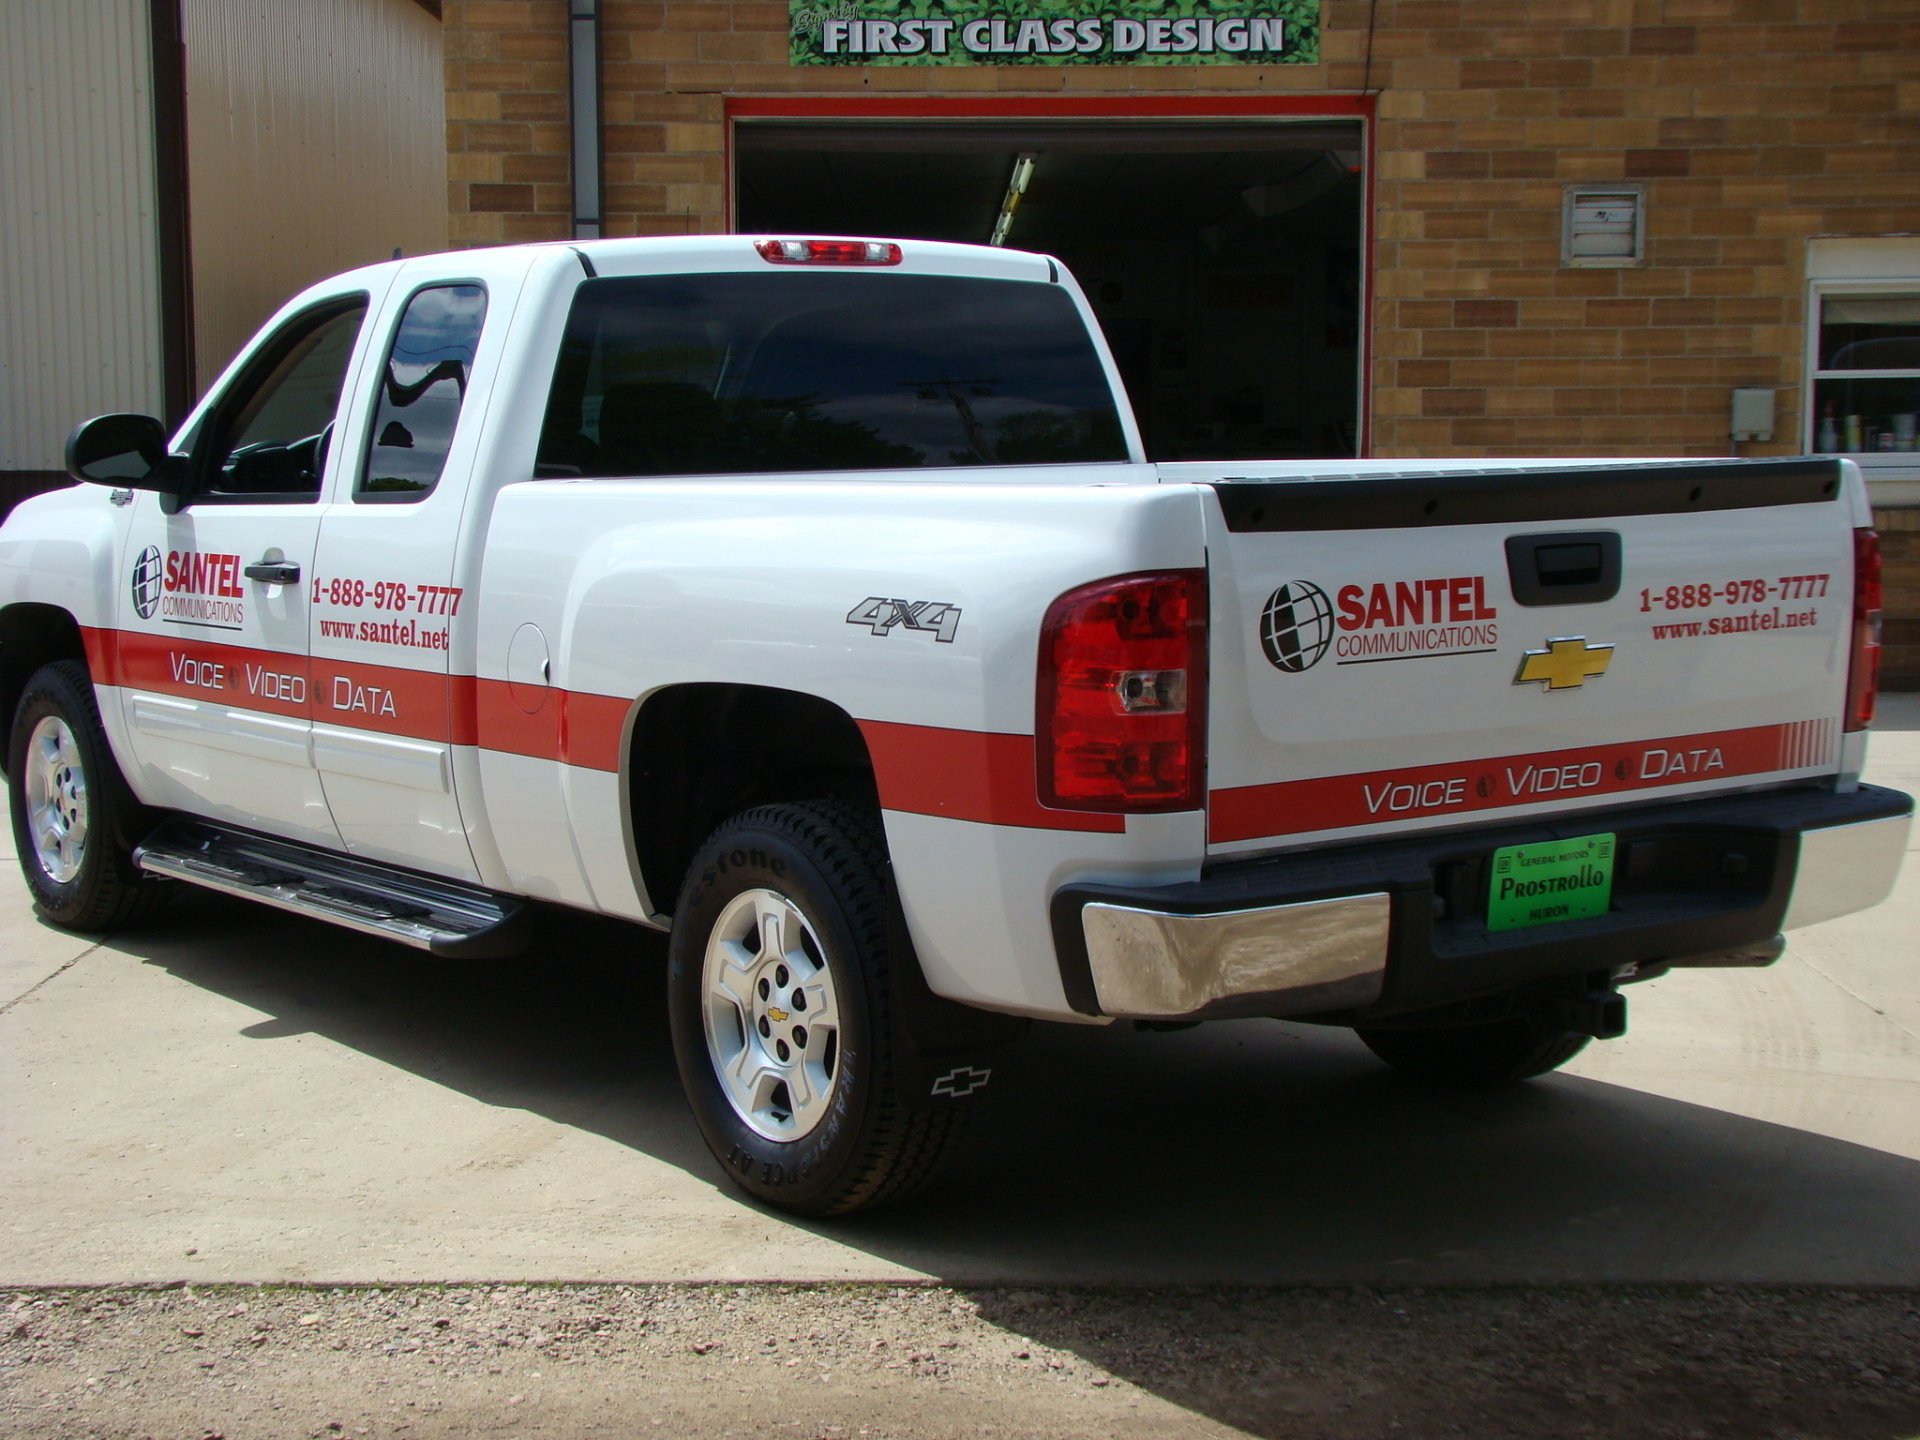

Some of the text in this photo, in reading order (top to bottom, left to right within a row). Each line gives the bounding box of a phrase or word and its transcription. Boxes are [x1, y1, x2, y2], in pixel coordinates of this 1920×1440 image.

[822, 18, 1284, 54] FIRST CLASS DESIGN
[164, 550, 244, 599] SANTEL
[162, 596, 243, 623] COMMUNICATIONS
[312, 577, 463, 616] 1-888-978-7777
[1336, 576, 1496, 631] SANTEL
[1640, 574, 1830, 613] 1-888-978-7777
[320, 619, 449, 650] www.santel.net
[846, 596, 962, 643] 4X4
[1651, 606, 1818, 641] www.santel.net
[1337, 624, 1497, 658] COMMUNICATIONS
[170, 651, 396, 718] VOICE VIDEO DATA
[1364, 747, 1724, 814] VOICE VIDEO DATA
[1520, 855, 1555, 867] GENERAL
[1559, 850, 1589, 862] MOTORS
[1529, 904, 1569, 921] HURON
